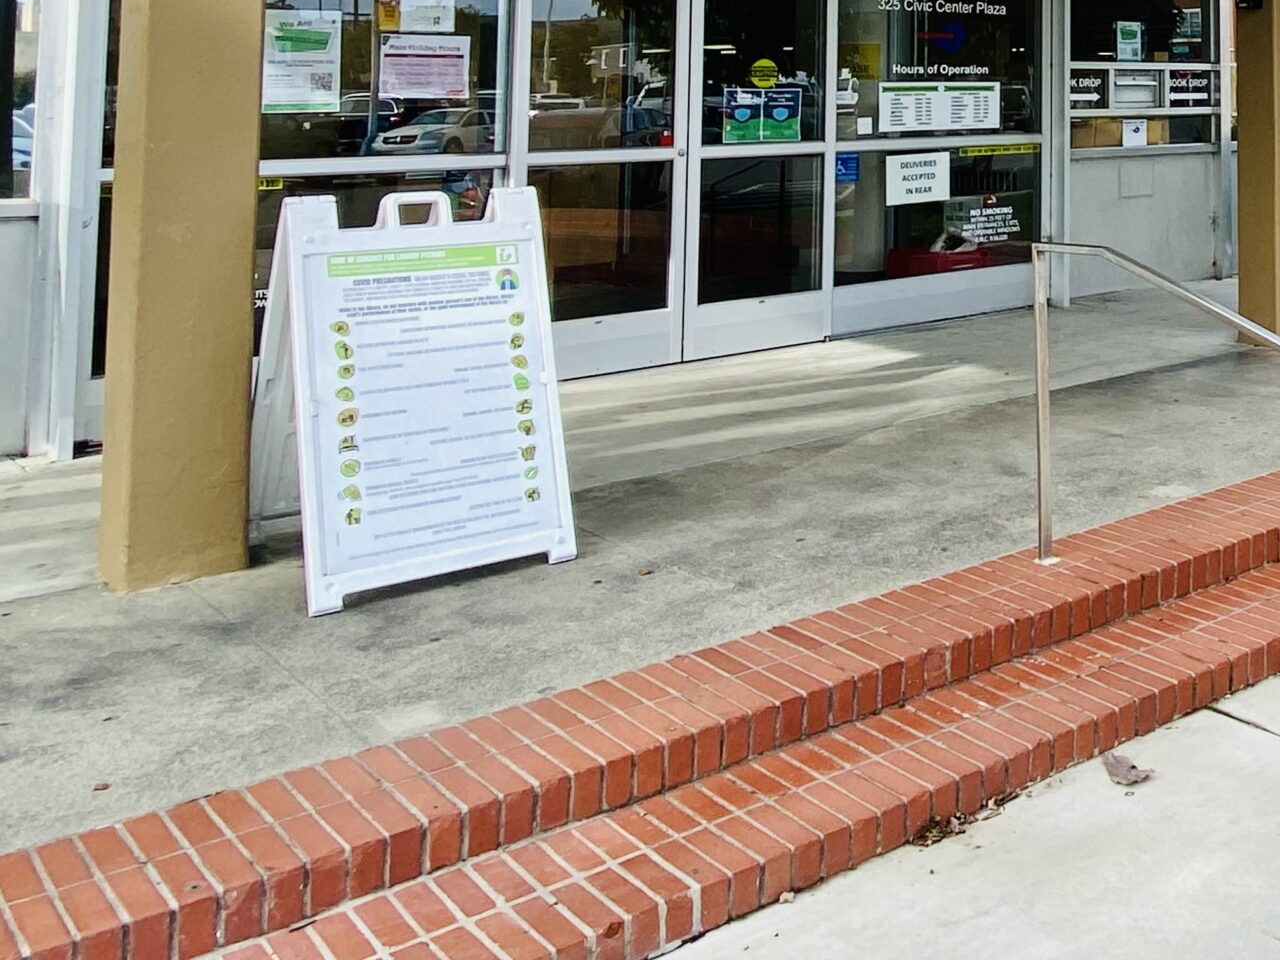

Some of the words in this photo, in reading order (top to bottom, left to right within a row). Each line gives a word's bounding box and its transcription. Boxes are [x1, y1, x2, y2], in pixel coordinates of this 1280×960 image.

[935, 0, 974, 13] Center
[976, 1, 1006, 15] Plaza
[892, 64, 925, 74] Hours
[927, 64, 938, 74] of
[940, 64, 989, 76] Operation
[1078, 78, 1102, 87] DROP
[1189, 78, 1208, 87] DROP
[900, 160, 937, 169] DELIVERIES
[902, 173, 936, 182] ACCEPTED
[905, 187, 913, 195] IN
[914, 186, 933, 195] REAR
[982, 206, 1013, 216] SMOKING
